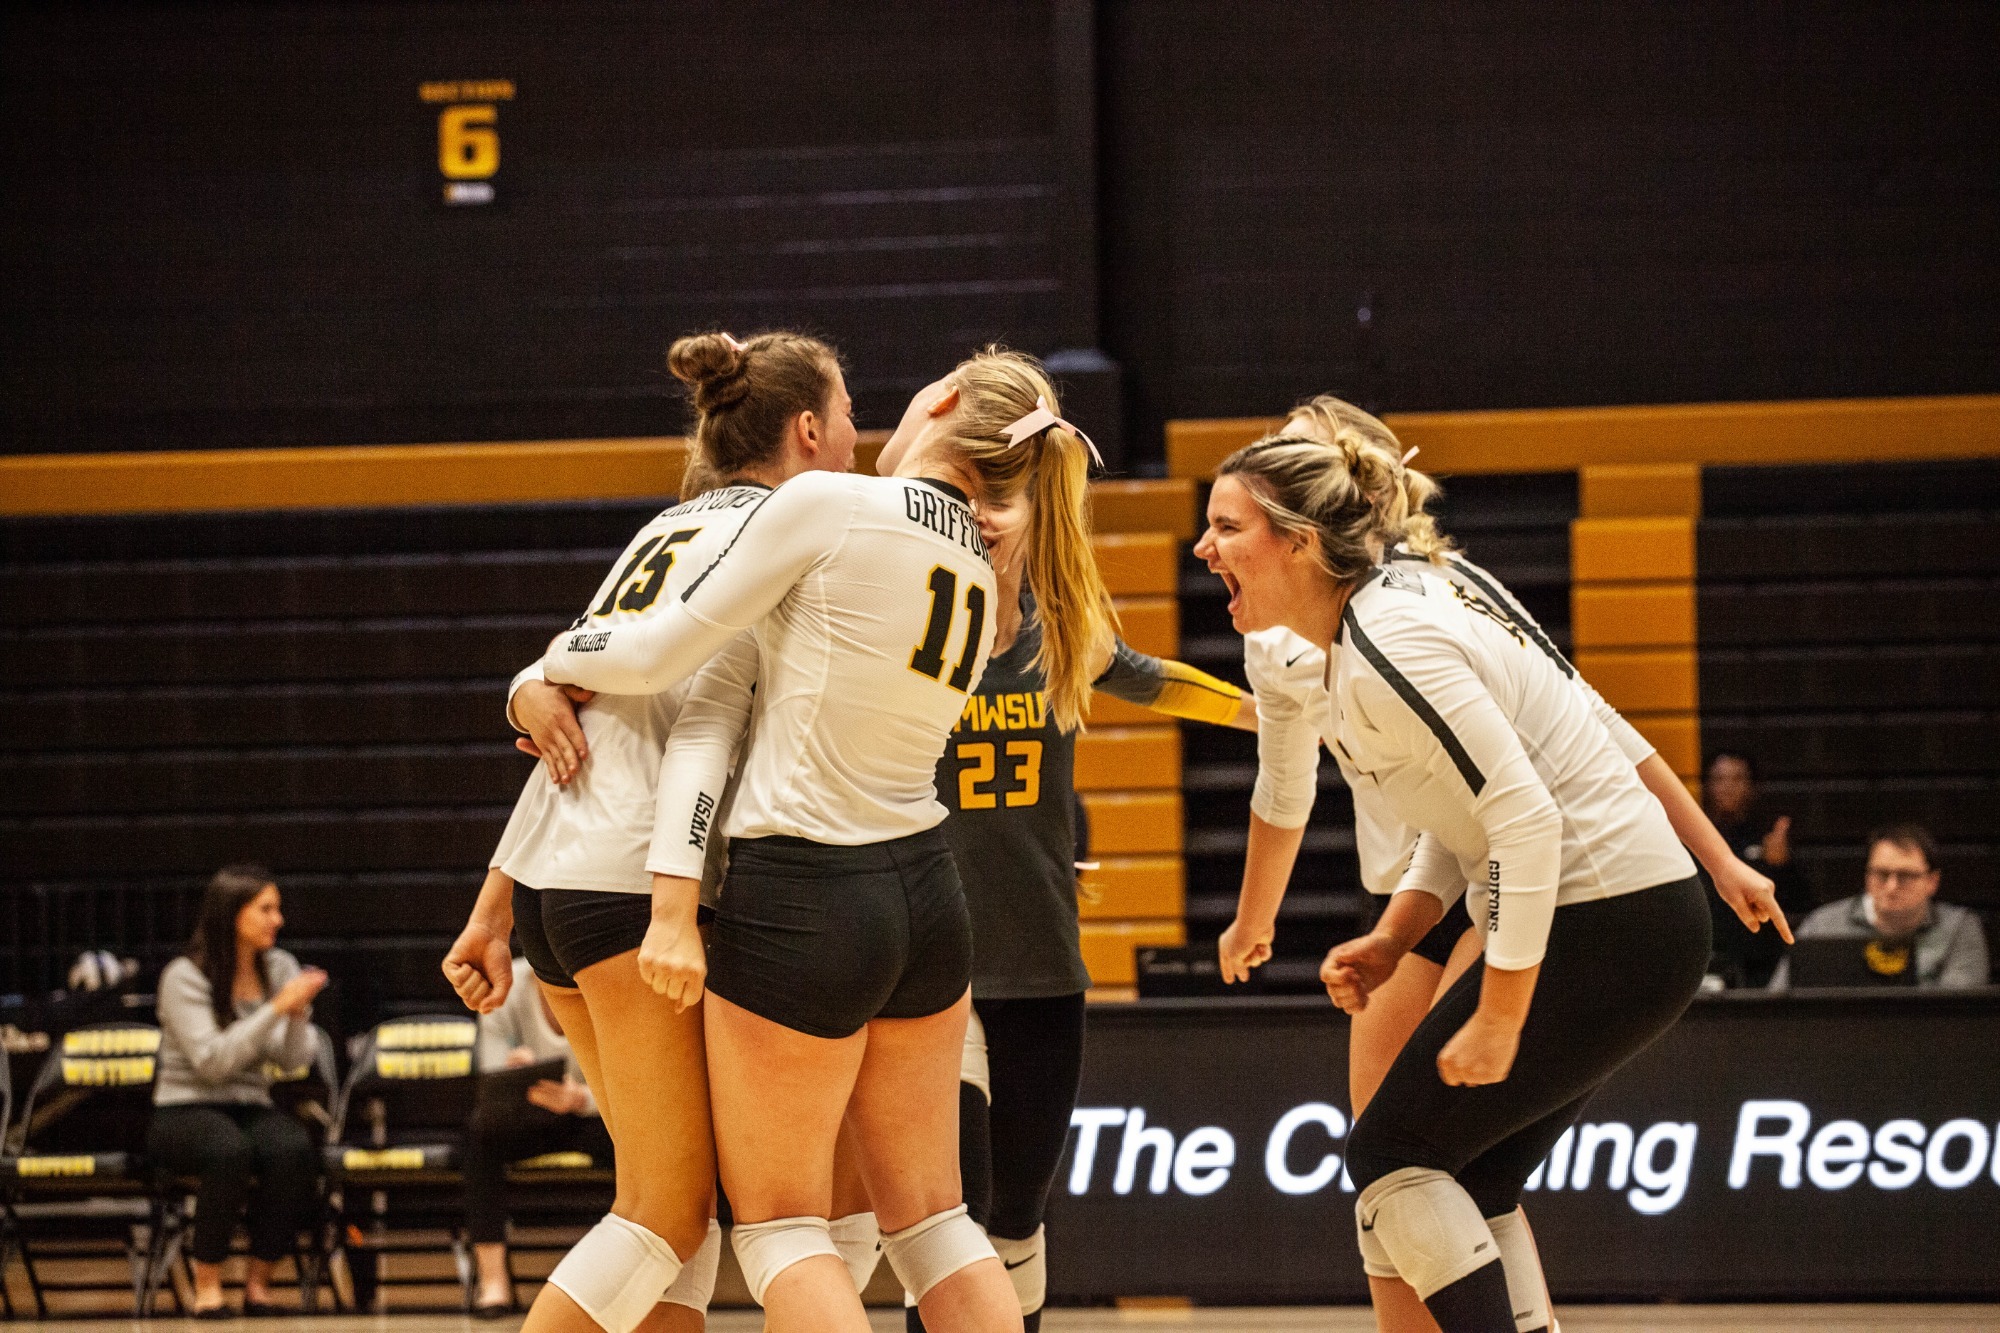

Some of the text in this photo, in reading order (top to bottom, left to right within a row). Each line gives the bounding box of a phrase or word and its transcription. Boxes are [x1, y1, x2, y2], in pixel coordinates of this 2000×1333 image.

[437, 103, 500, 181] 6
[903, 486, 994, 571] GRIFFON
[592, 526, 705, 618] 15
[907, 563, 986, 696] 11
[952, 691, 1047, 733] MWSU
[956, 740, 1044, 810] 23
[688, 790, 715, 852] MWSU
[1069, 1106, 1236, 1196] The
[1727, 1099, 2000, 1190] Reso
